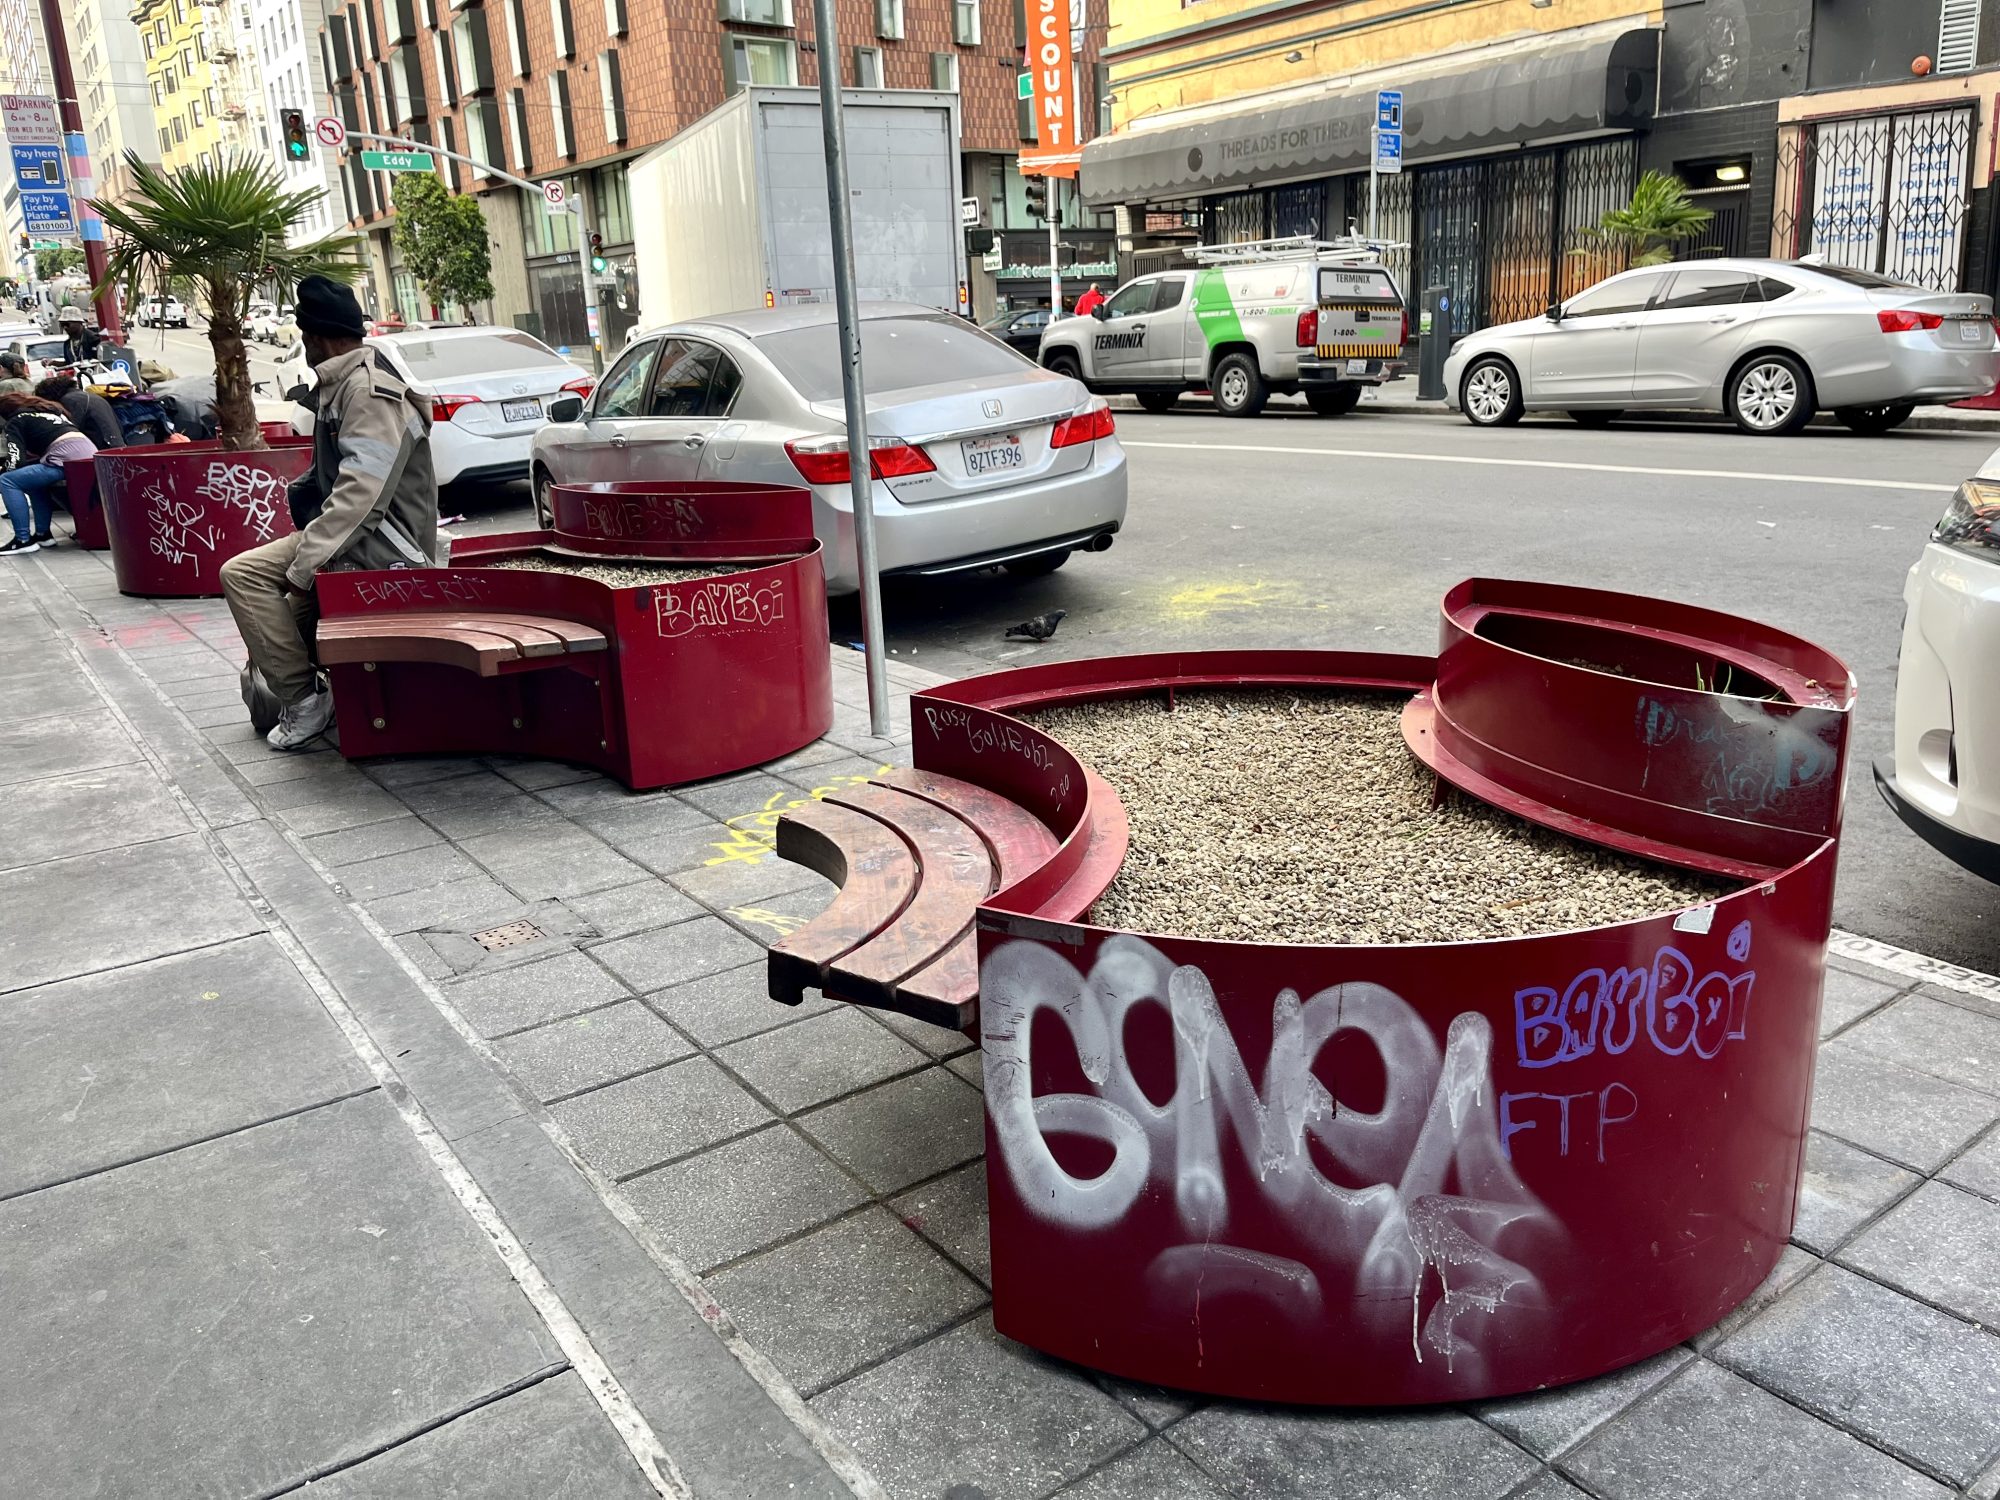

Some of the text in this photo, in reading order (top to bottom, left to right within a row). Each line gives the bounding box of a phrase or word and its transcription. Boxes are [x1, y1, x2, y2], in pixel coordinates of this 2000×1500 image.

[2, 96, 53, 110] NO PARKING
[11, 113, 17, 121] 6
[34, 112, 40, 121] 8
[1220, 134, 1277, 160] THREADS
[1281, 129, 1309, 150] FOR
[14, 149, 58, 160] Pay here
[382, 155, 412, 168] Eddy
[1910, 160, 1949, 173] GRACE
[1838, 167, 1861, 177] FOR
[1824, 183, 1873, 195] NOTHING
[1899, 176, 1959, 190] YOU HAVE
[23, 194, 55, 206] Pay by
[31, 222, 70, 231] 68101003
[1816, 232, 1873, 244] WTH GOD
[1896, 229, 1955, 241] THROUGH
[1905, 246, 1940, 257] FATH
[1336, 273, 1371, 284] TERMINIX
[1095, 332, 1146, 350] TERMINIX
[969, 446, 1022, 471] 8ZTF396
[354, 577, 434, 605] EVADE
[1500, 1082, 1638, 1163] FTP
